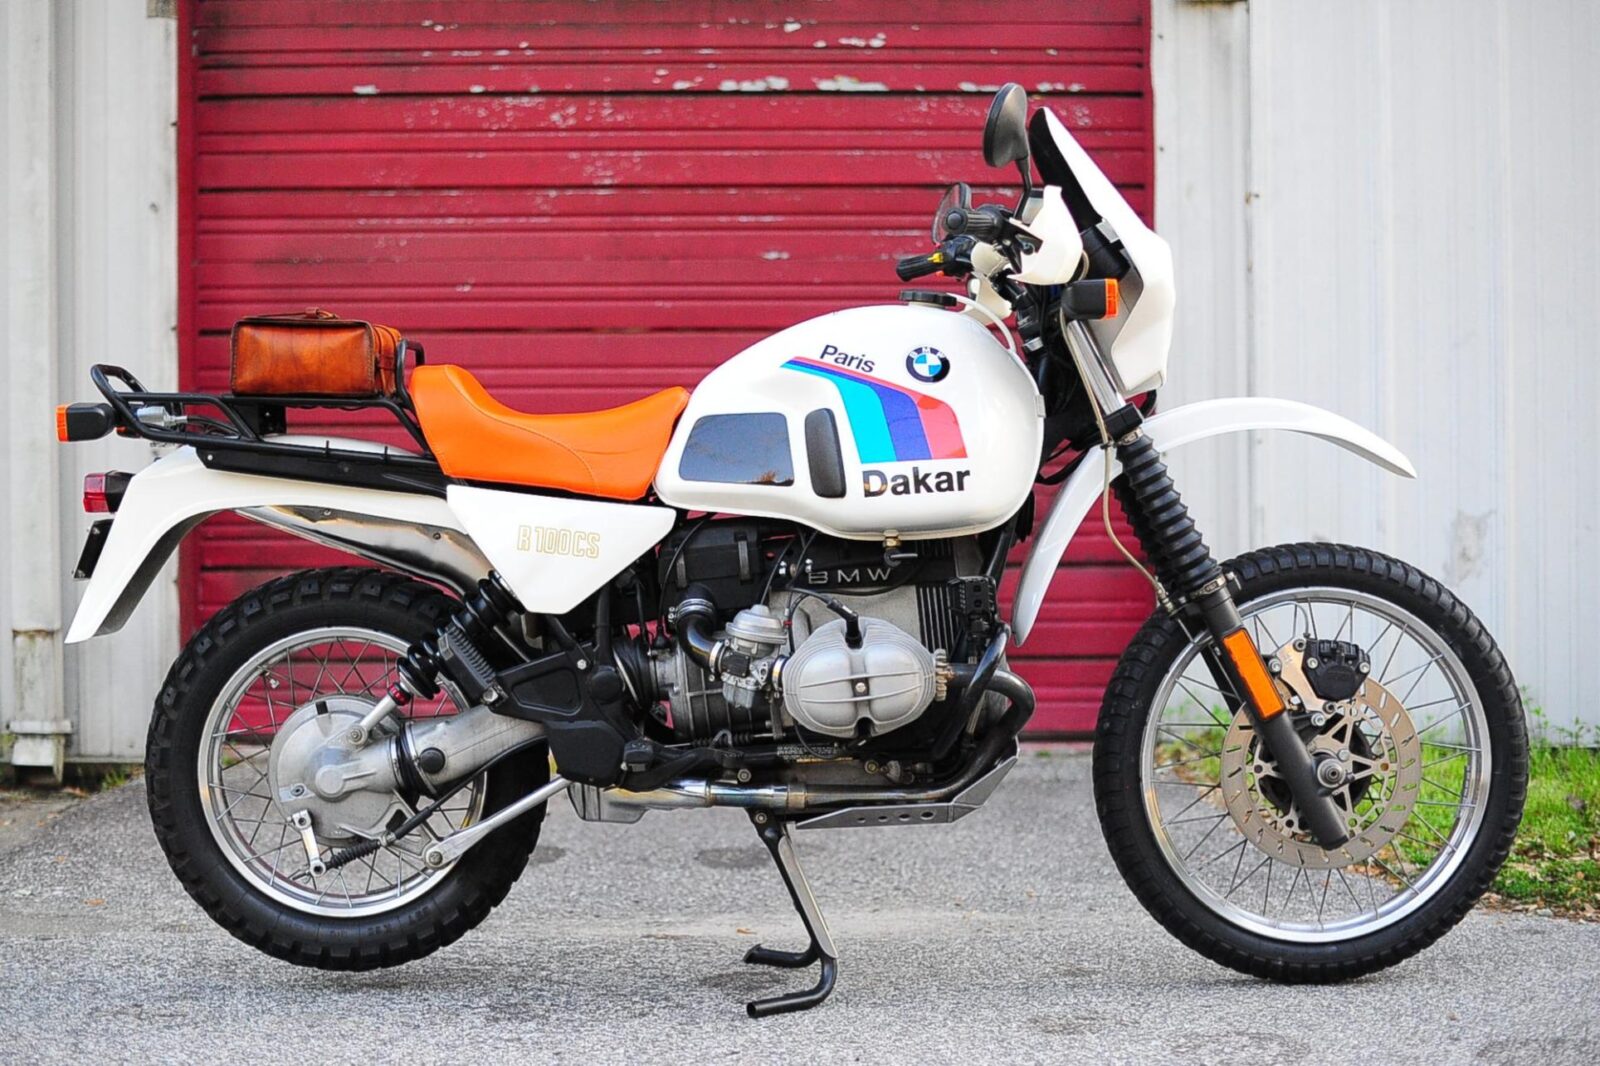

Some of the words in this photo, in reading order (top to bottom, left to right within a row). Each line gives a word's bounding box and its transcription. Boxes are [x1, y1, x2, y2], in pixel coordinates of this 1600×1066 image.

[819, 344, 875, 373] Paris
[862, 466, 970, 497] Dakar
[808, 567, 891, 584] BMW
